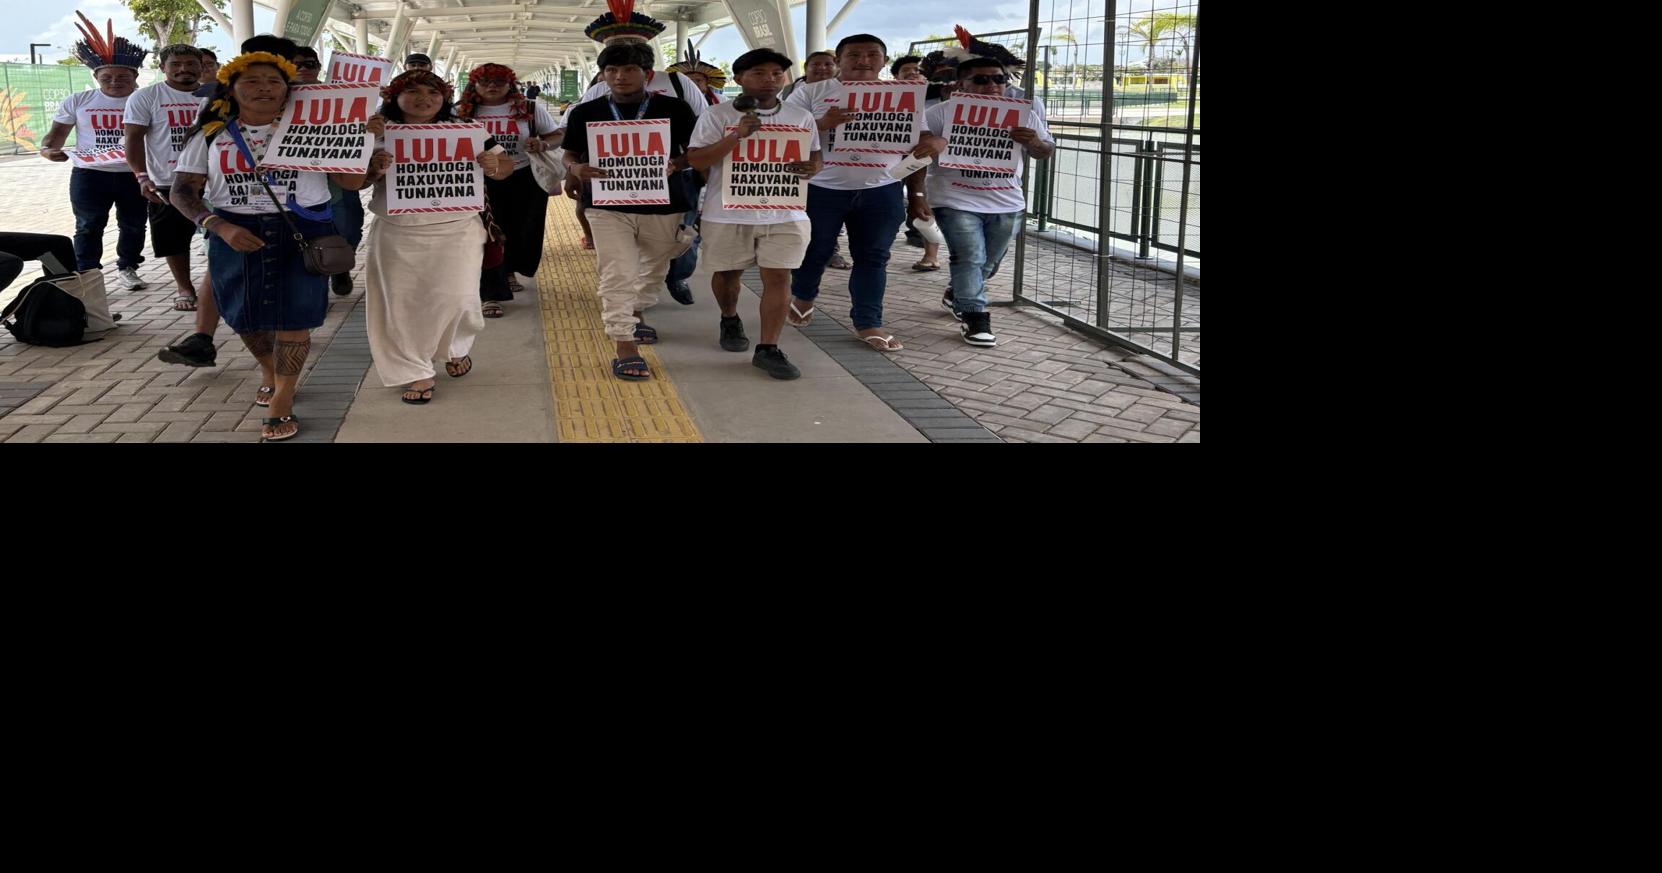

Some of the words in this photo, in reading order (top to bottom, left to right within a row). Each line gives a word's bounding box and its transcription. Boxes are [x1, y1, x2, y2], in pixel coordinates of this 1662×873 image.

[331, 61, 382, 82] LULA
[847, 91, 916, 112] LULA
[291, 96, 368, 125] LULA
[952, 103, 1020, 129] LULA
[286, 123, 367, 135] HOMOLOGA
[844, 122, 912, 133] KAXUYANA
[951, 125, 1012, 138] HOMOLOG
[281, 135, 365, 147] KAXUYANA
[843, 132, 911, 144] TUNAYANA
[949, 135, 1014, 150] KAXUYANA
[395, 137, 475, 163] LULA
[596, 132, 665, 158] LULA
[732, 139, 801, 163] LULA
[277, 146, 362, 159] TUNAYANA
[947, 145, 1012, 161] TUNAYANA
[396, 162, 475, 174] HOMOLOGA
[598, 156, 665, 168] HOMOLOGA
[396, 173, 475, 186] KAXUYANA
[607, 168, 664, 179] AXUYANA
[731, 174, 800, 185] KAXUYANA
[599, 180, 665, 191] TUNAYANA
[729, 185, 800, 197] TUNAYANA
[395, 186, 475, 199] TUNAYANA
